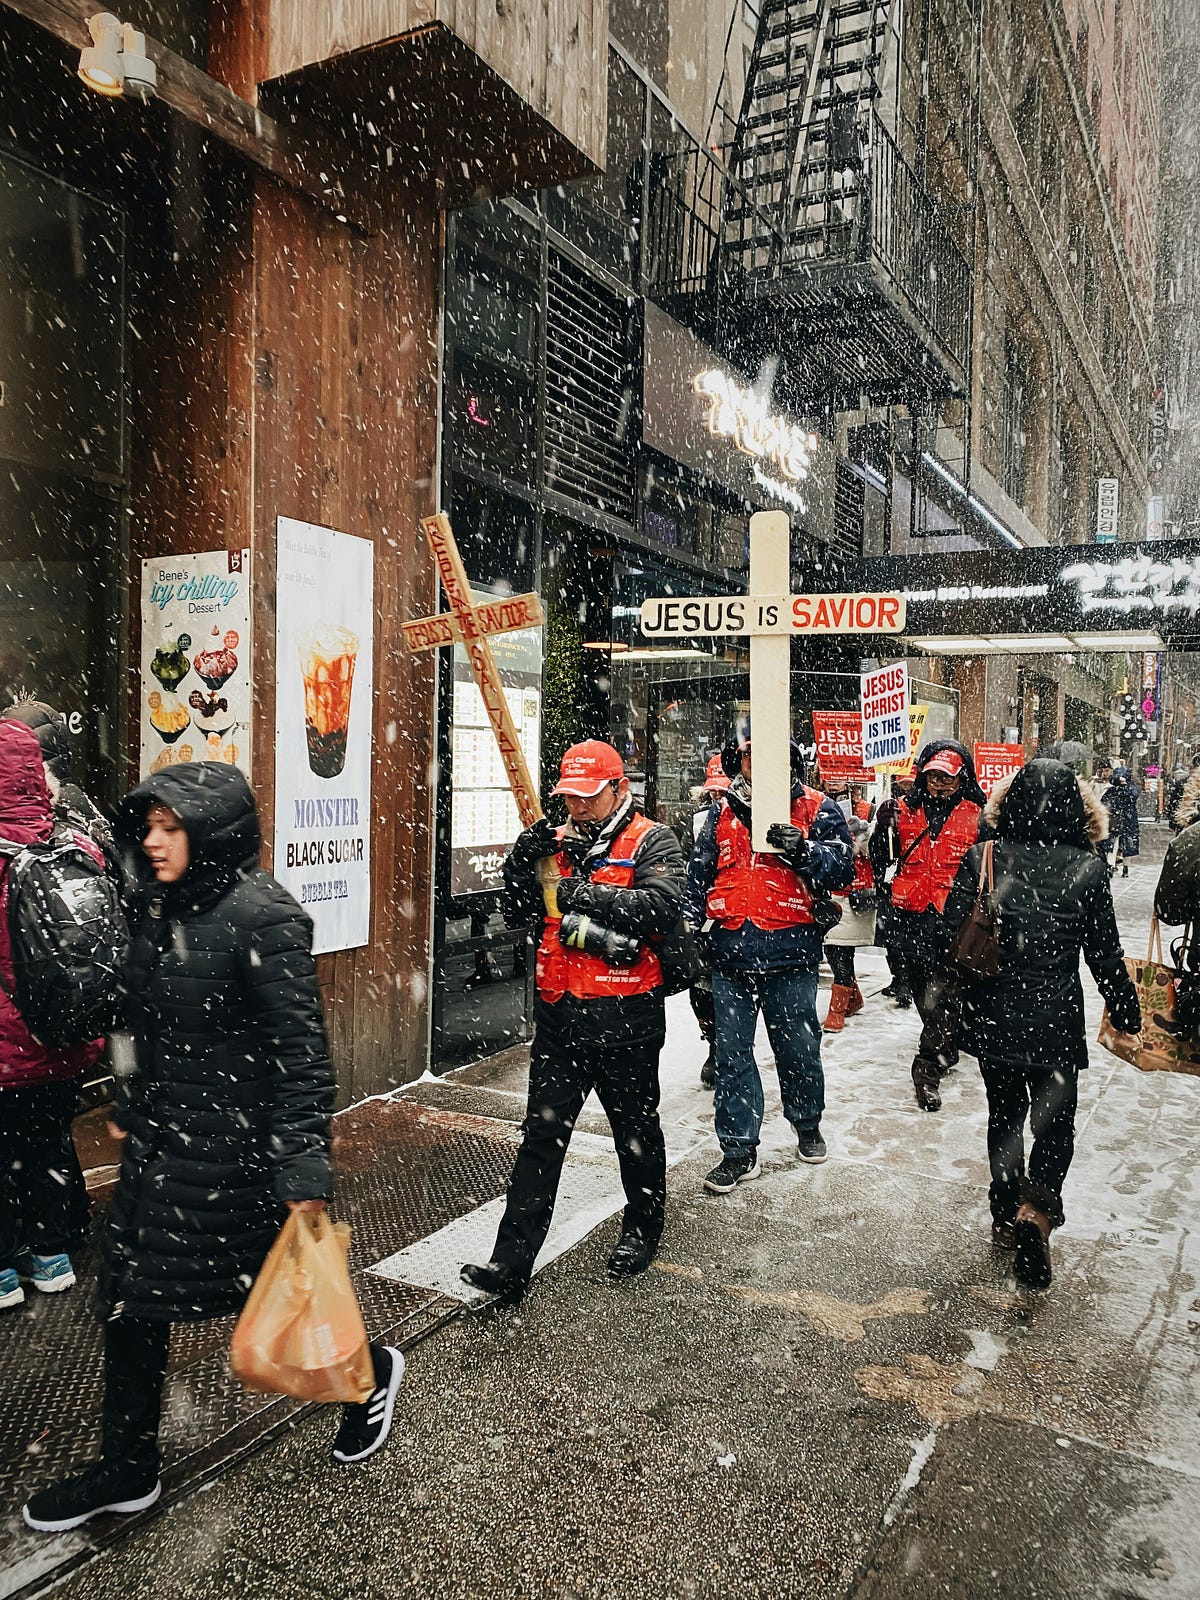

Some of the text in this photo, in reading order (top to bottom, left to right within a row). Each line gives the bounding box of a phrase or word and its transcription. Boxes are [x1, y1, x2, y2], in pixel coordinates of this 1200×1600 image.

[158, 569, 189, 582] Bene's
[150, 574, 239, 610] icy chilling
[188, 601, 222, 614] Dessert
[477, 601, 535, 633] SAVIOR
[644, 597, 900, 632] JESUS IS SAVIOR
[1145, 653, 1154, 685] SPA
[863, 668, 905, 699] JESUS
[863, 692, 906, 720] CHRIST
[917, 713, 925, 724] in
[818, 729, 862, 743] JESU
[868, 722, 879, 739] IS
[881, 717, 901, 735] THE
[818, 743, 862, 757] CHRIS
[864, 736, 906, 761] SAVIOR
[294, 798, 359, 828] MONSTER
[286, 838, 364, 868] BLACK SUGAR
[301, 880, 348, 904] BUBBLE TEA
